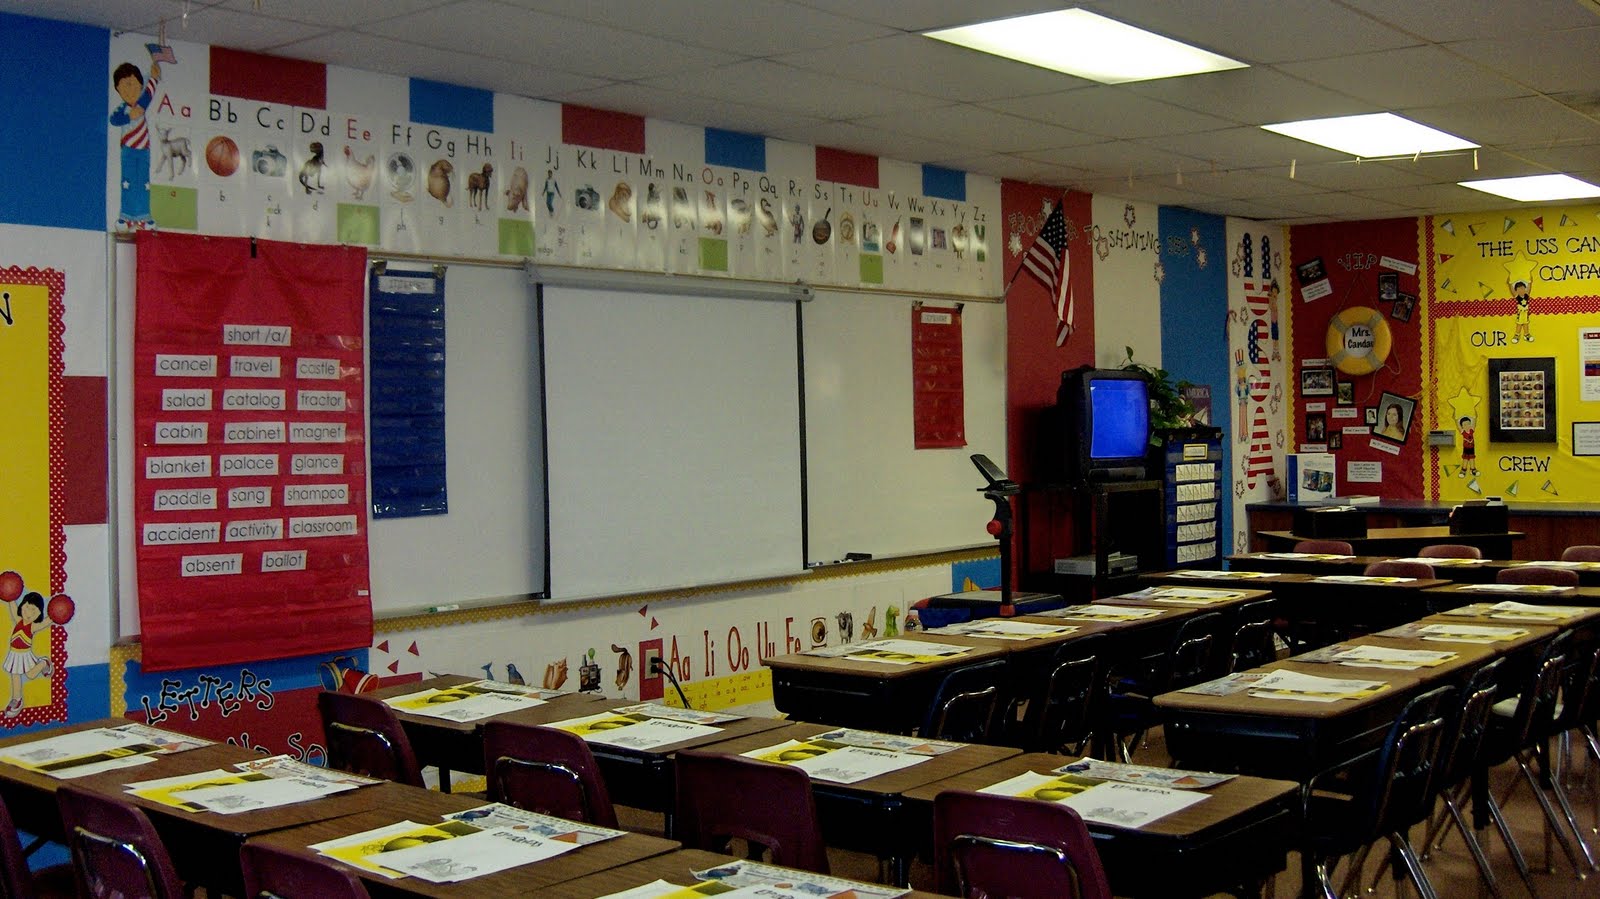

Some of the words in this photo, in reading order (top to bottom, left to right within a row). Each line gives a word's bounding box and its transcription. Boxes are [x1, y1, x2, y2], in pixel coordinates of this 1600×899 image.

[1108, 229, 1162, 255] SHINING
[1477, 240, 1513, 257] THE
[1526, 237, 1559, 255] USS
[1337, 252, 1378, 271] VIP
[1540, 263, 1600, 281] COMPA
[228, 329, 259, 342] short
[1470, 331, 1507, 347] OUR
[160, 358, 211, 371] cancel
[234, 359, 272, 372] travel
[300, 361, 335, 375] castle
[166, 394, 206, 407] salad
[226, 393, 280, 409] catalog
[301, 394, 342, 407] tractor
[159, 425, 203, 439] cabin
[228, 427, 281, 441] cabinet
[293, 426, 342, 440] magnet
[150, 460, 205, 474] blanket
[223, 456, 274, 472] palace
[295, 456, 338, 471] glance
[1498, 456, 1551, 472] CREW
[158, 492, 211, 507] paddle
[232, 490, 265, 504] sang
[287, 488, 345, 502] shampoo
[229, 523, 277, 538] activity
[293, 519, 353, 534] classroom
[147, 527, 216, 542] accident
[185, 559, 235, 573] absent
[265, 554, 302, 568] ballot
[142, 669, 274, 724] LETTERS
